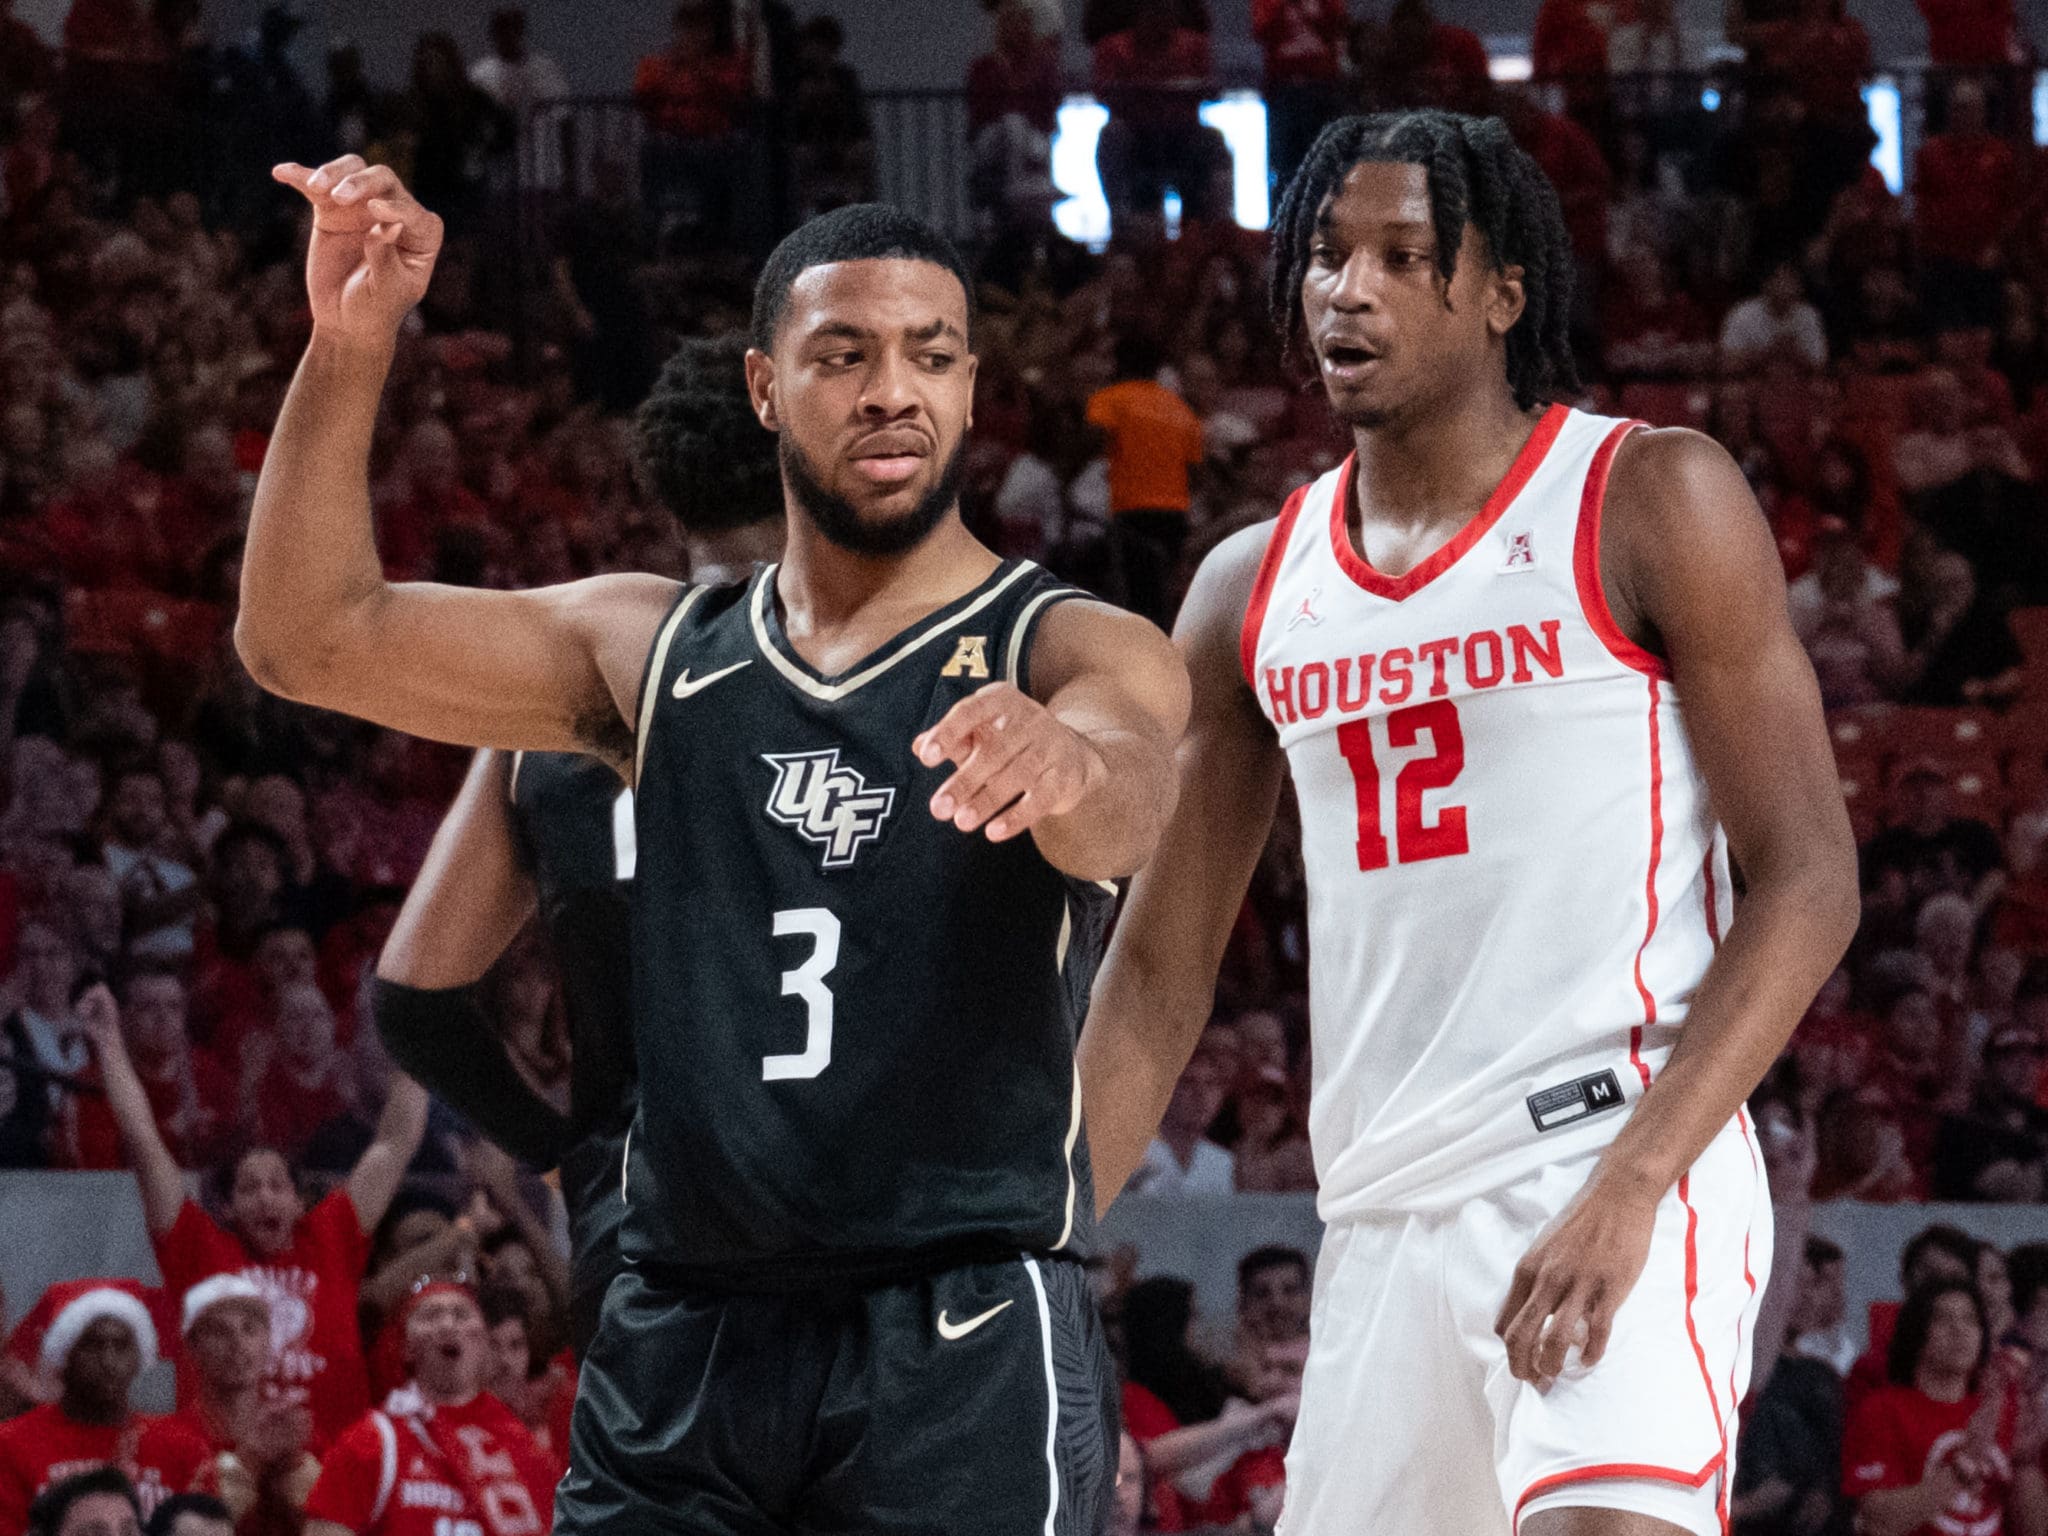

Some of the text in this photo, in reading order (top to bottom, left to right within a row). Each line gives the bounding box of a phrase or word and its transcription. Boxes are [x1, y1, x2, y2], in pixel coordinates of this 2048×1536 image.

[1265, 619, 1564, 725] HOUSTON
[761, 748, 896, 867] UCF
[1336, 698, 1470, 872] 12
[761, 907, 842, 1082] 3
[1592, 1082, 1611, 1100] M
